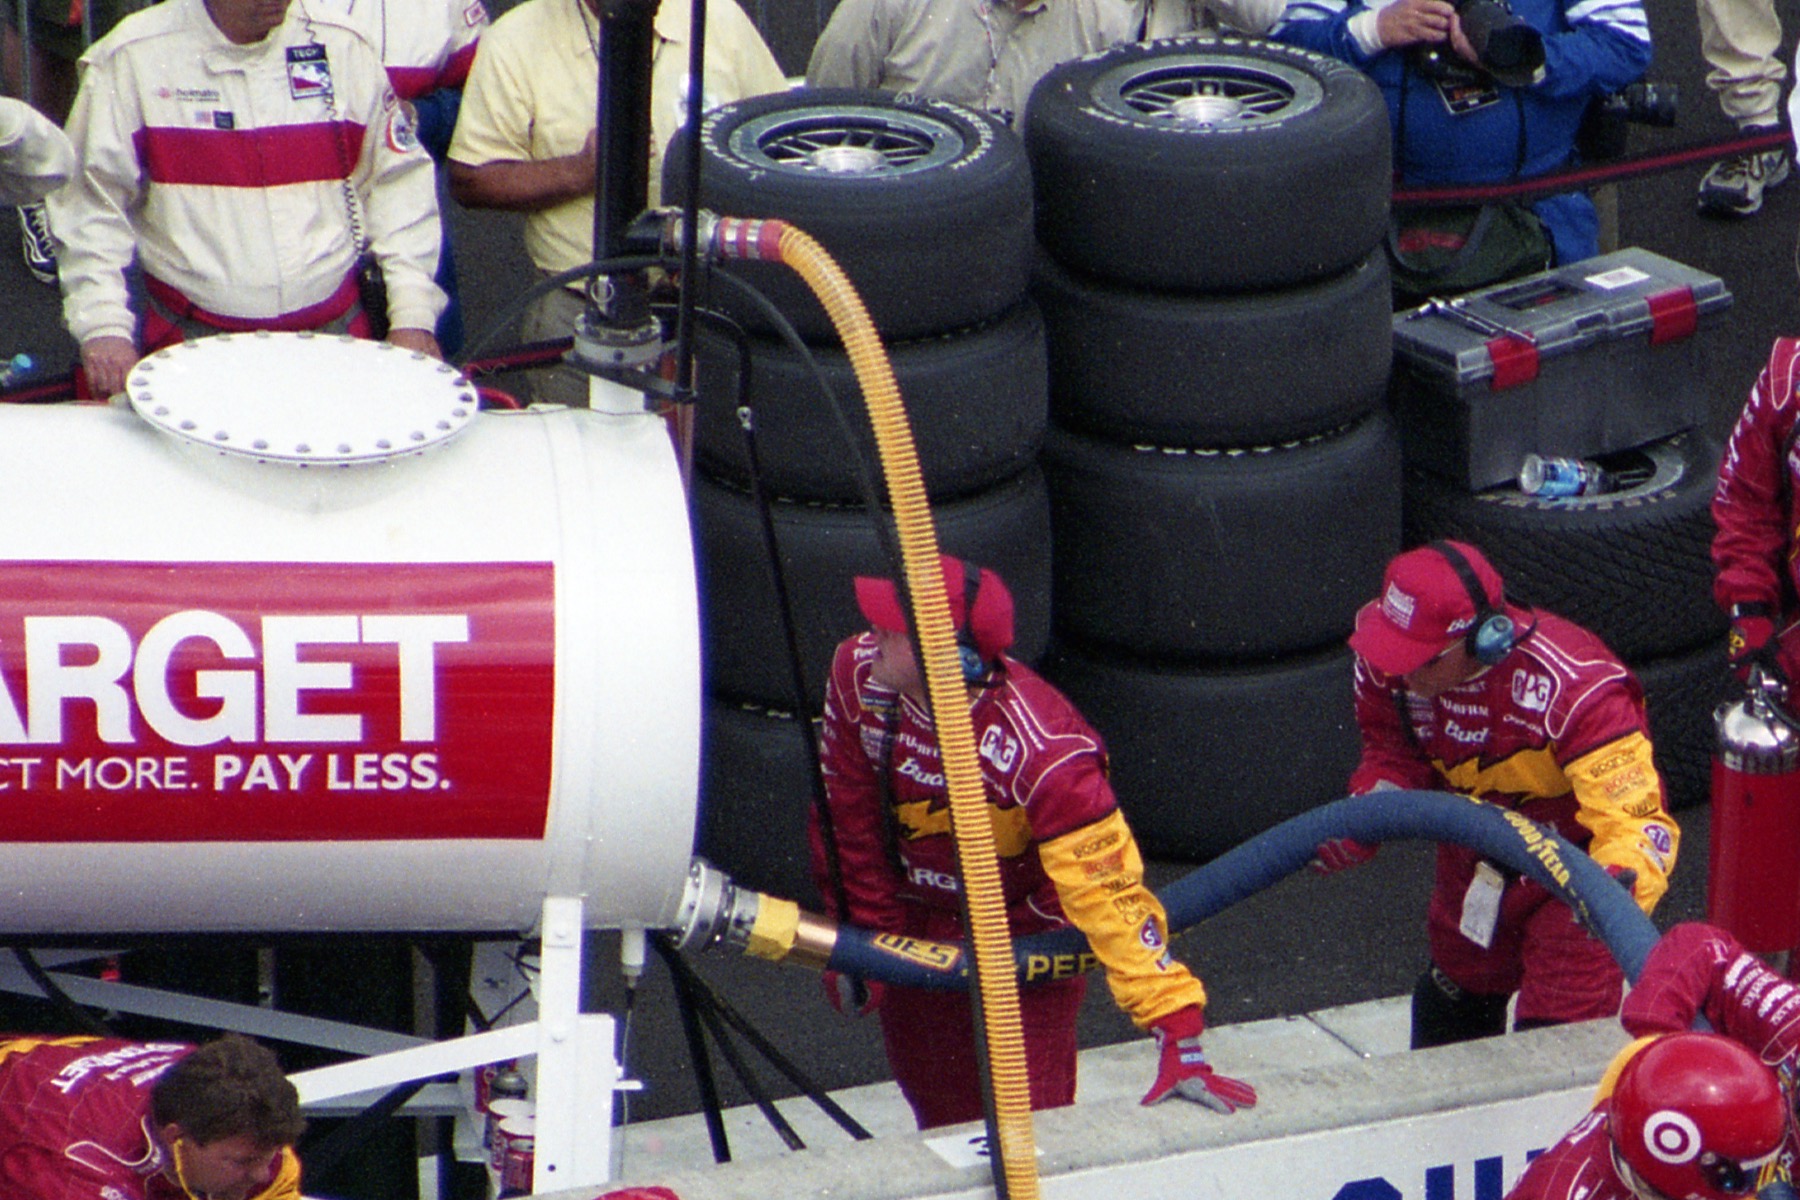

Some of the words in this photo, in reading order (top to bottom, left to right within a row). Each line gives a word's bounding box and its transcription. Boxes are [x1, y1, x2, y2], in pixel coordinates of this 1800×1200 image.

[1444, 719, 1488, 743] Bud
[56, 757, 199, 790] MORE.
[213, 753, 313, 791] PAY
[327, 754, 451, 791] LESS.
[1503, 811, 1571, 887] GOODYEAR
